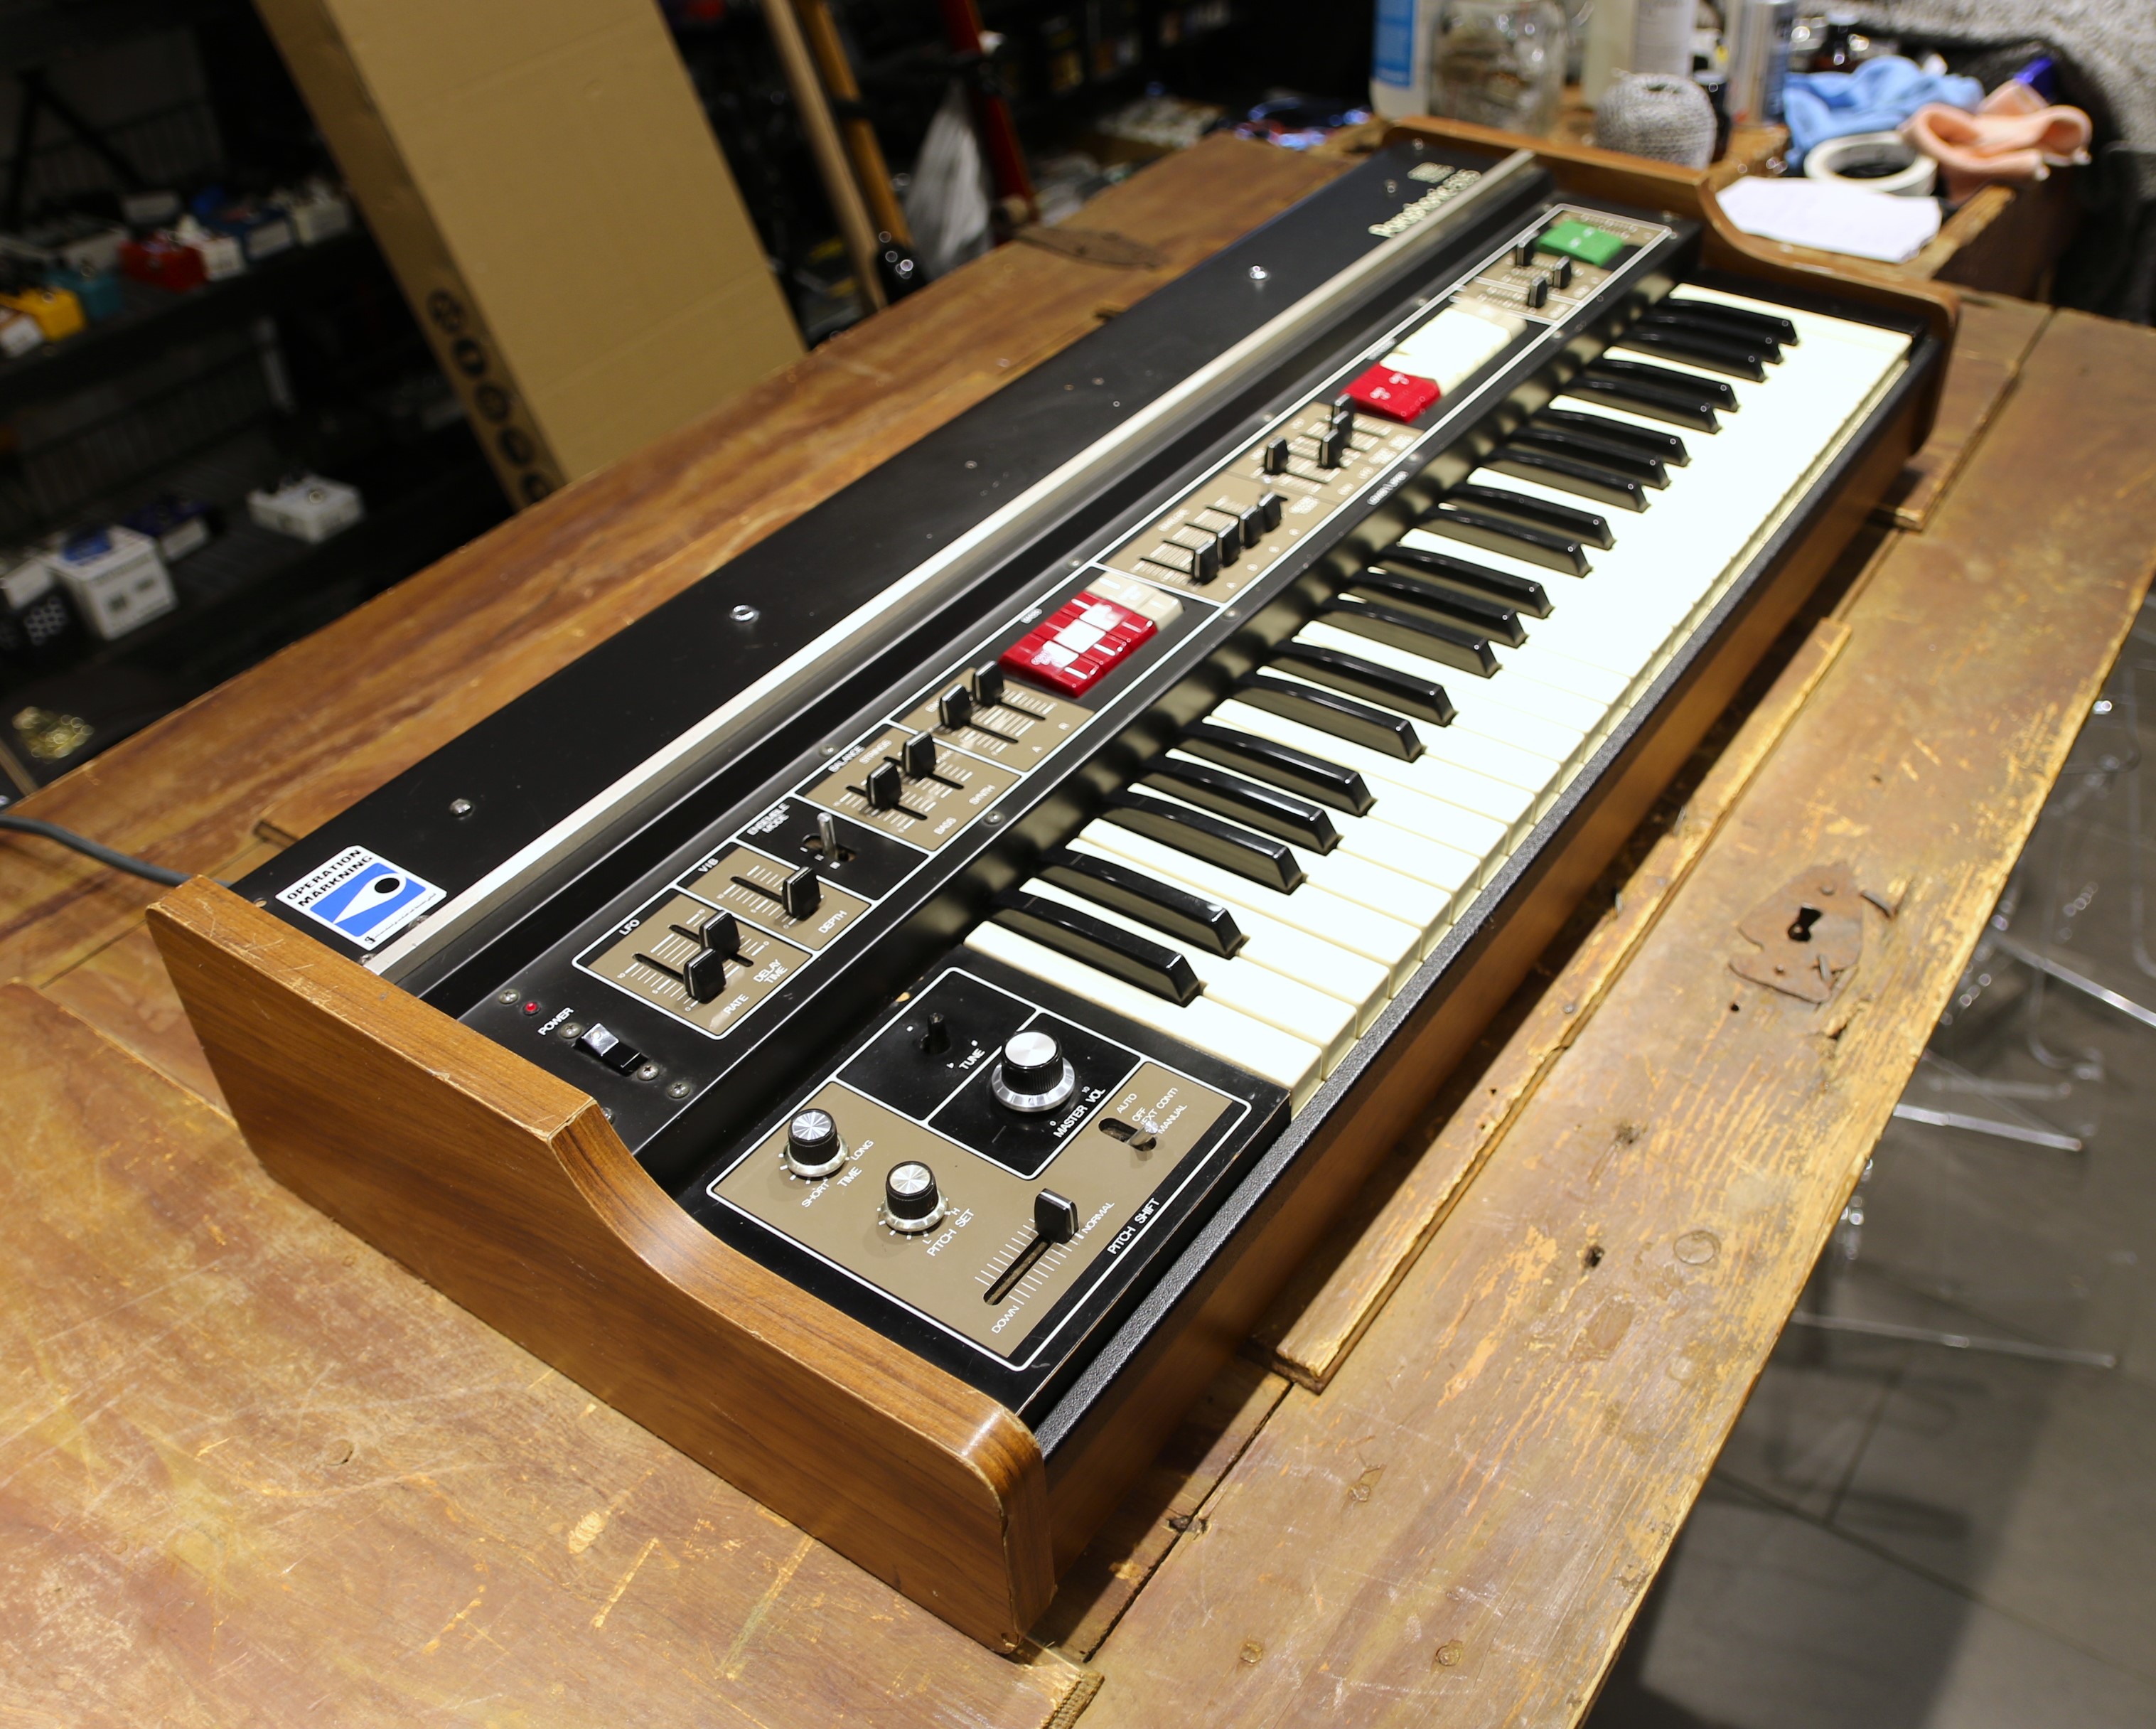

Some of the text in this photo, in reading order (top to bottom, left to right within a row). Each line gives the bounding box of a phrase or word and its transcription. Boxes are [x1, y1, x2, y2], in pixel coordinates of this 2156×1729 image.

[286, 850, 361, 899] OPERATION
[697, 858, 719, 872] VIB
[618, 919, 640, 936] LFO
[818, 910, 847, 933] DEPTH
[753, 959, 781, 983] DELAY
[763, 965, 788, 983] TIME
[724, 994, 749, 1015] RATE
[537, 1007, 574, 1035] POWER
[958, 1048, 985, 1069] TUNE
[1053, 1088, 1106, 1138] MASTER VOL
[1117, 1093, 1137, 1114] AUTO
[1132, 1107, 1146, 1121] OFF
[1158, 1105, 1187, 1134] MANUAL
[850, 1140, 874, 1161] LONG
[837, 1166, 862, 1187] TIME
[801, 1180, 829, 1207] SHORT
[1081, 1201, 1115, 1234] NORMAL
[1107, 1198, 1159, 1255] PITCH SHIFT
[926, 1209, 974, 1256] PITCH SET
[991, 1305, 1019, 1334] DOWN
